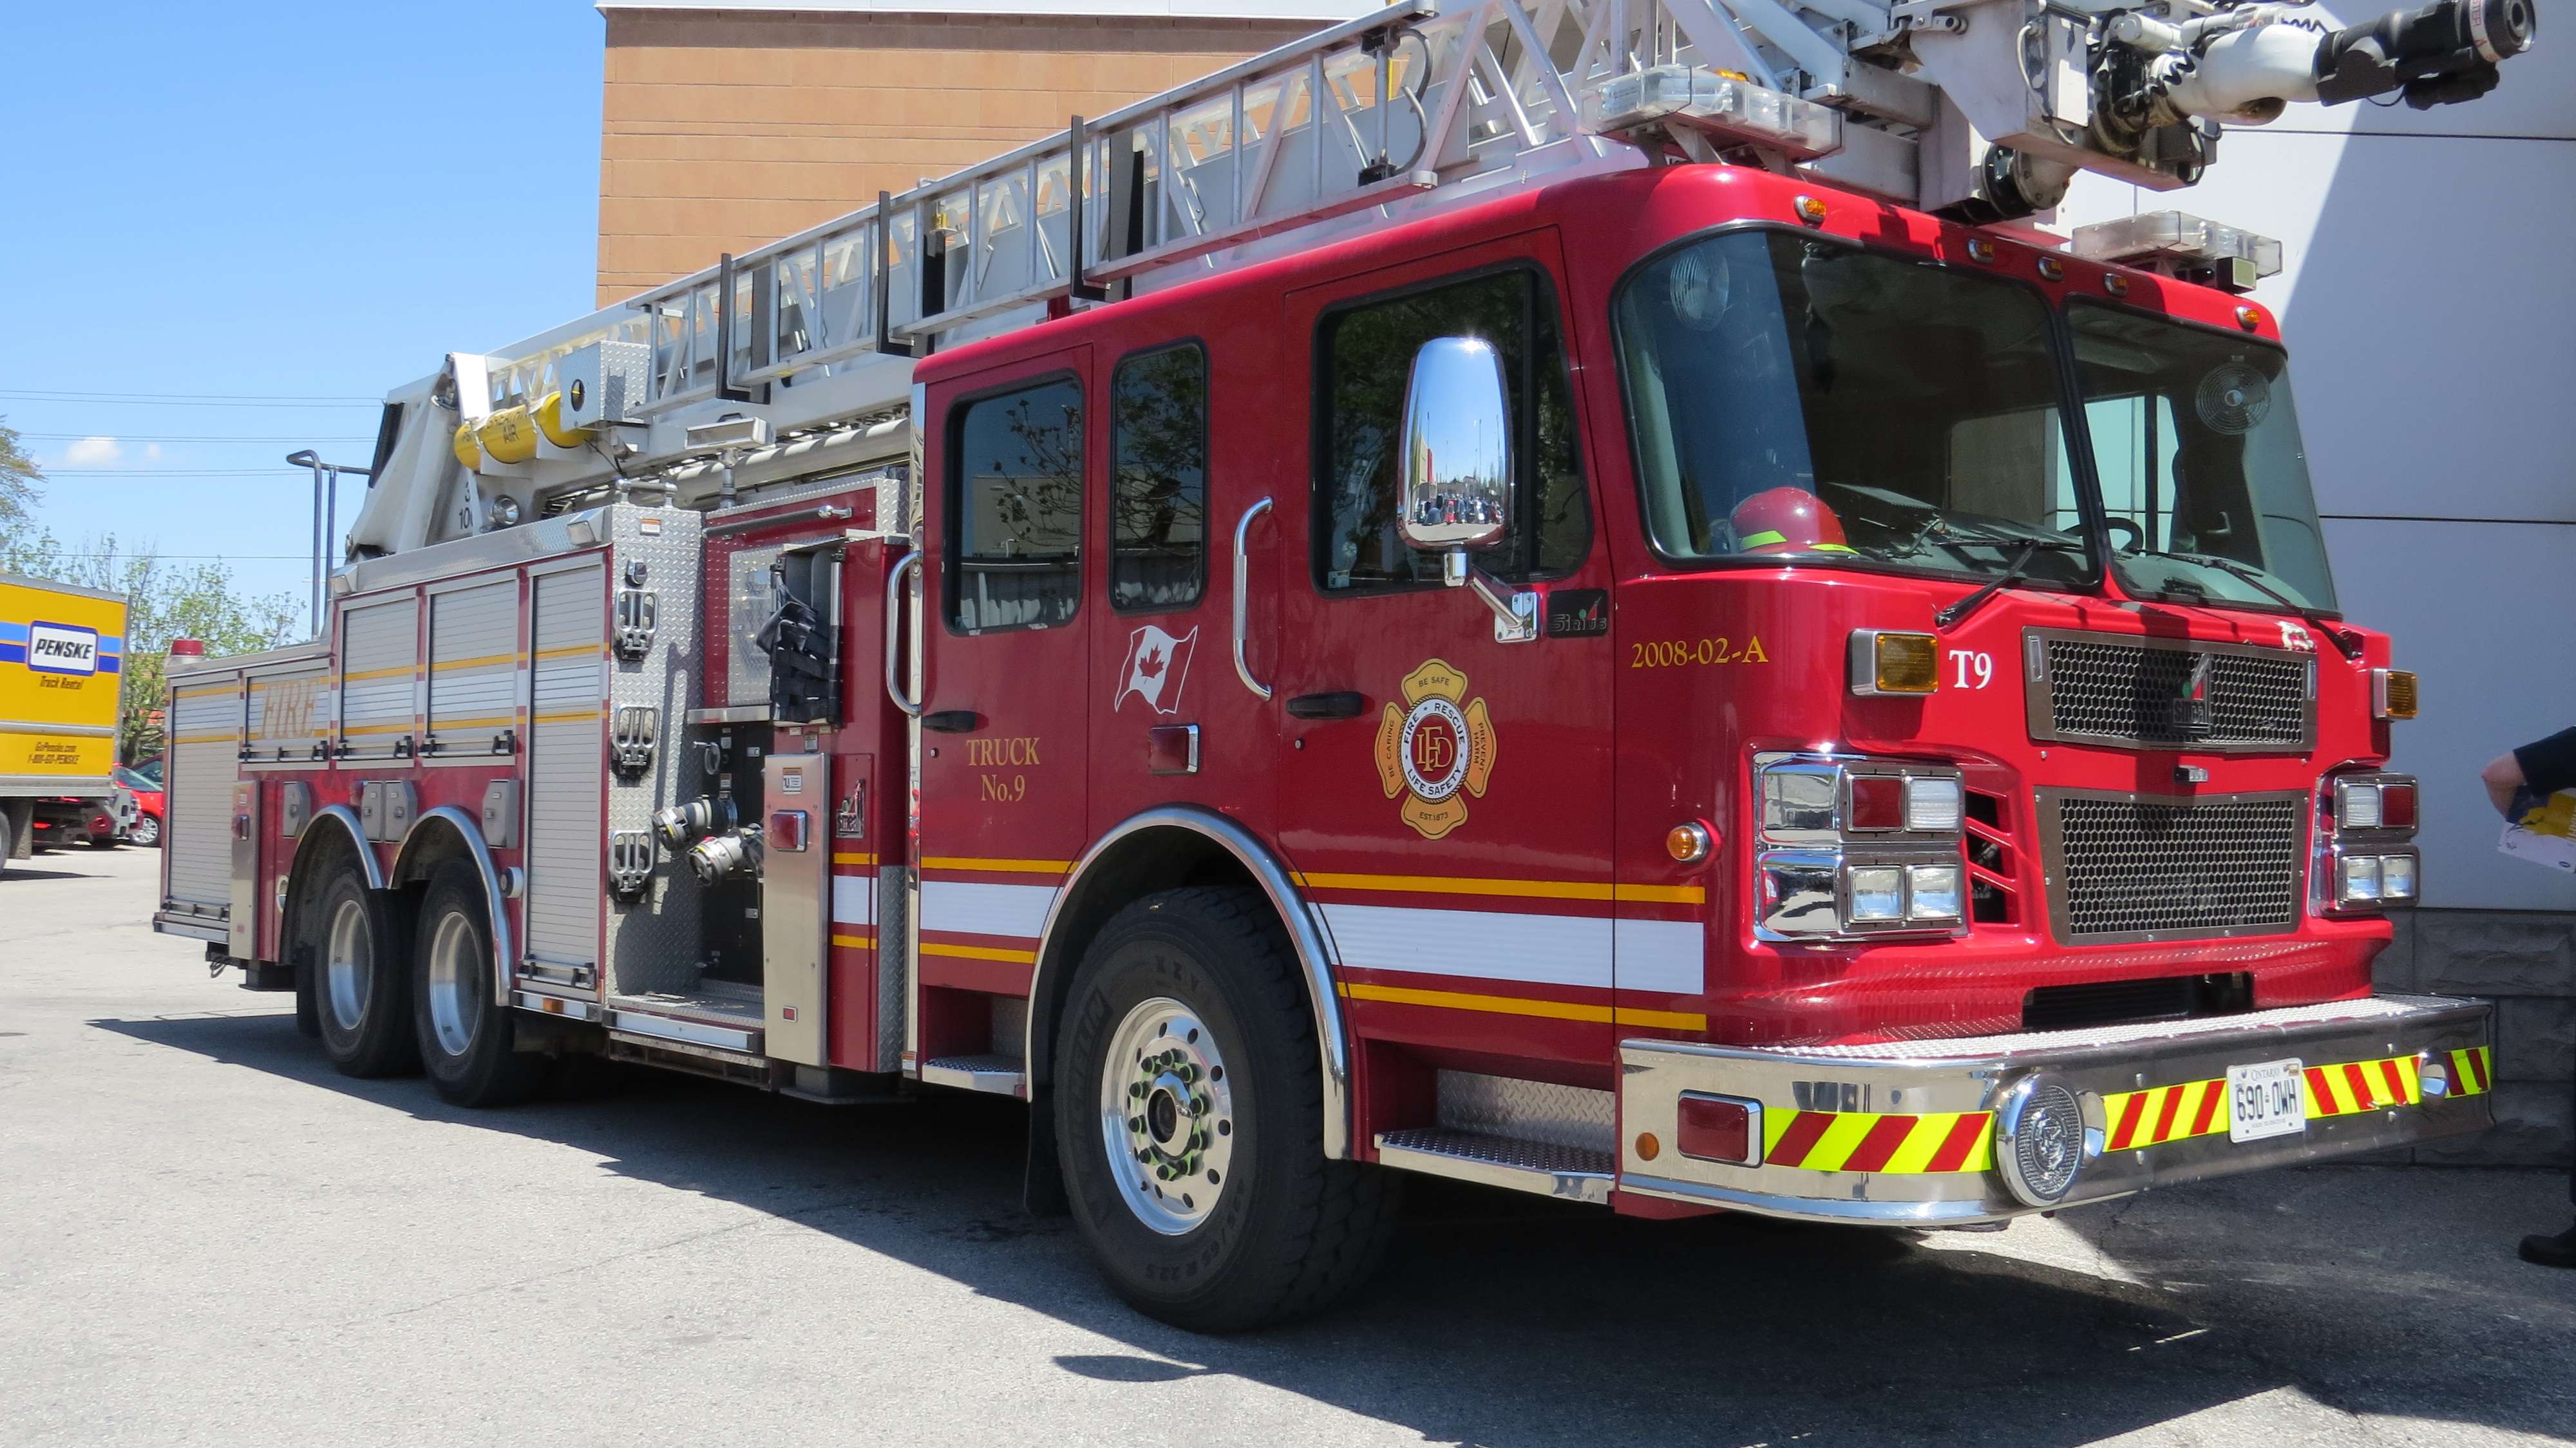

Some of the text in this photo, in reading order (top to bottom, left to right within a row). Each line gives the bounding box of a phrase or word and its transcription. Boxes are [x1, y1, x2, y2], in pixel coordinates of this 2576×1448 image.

[34, 638, 93, 659] PENSKE
[1631, 635, 1768, 668] 2008-02-A
[40, 675, 84, 690] Truck Rental
[1419, 676, 1450, 687] BE SAFE
[1949, 649, 1992, 690] T9
[1404, 703, 1465, 745] FIRE RESCUE
[967, 738, 1041, 766] TRUCK
[1388, 765, 1395, 777] BE
[1408, 765, 1461, 795] LIFE SAFETY
[981, 774, 1025, 801] No.9
